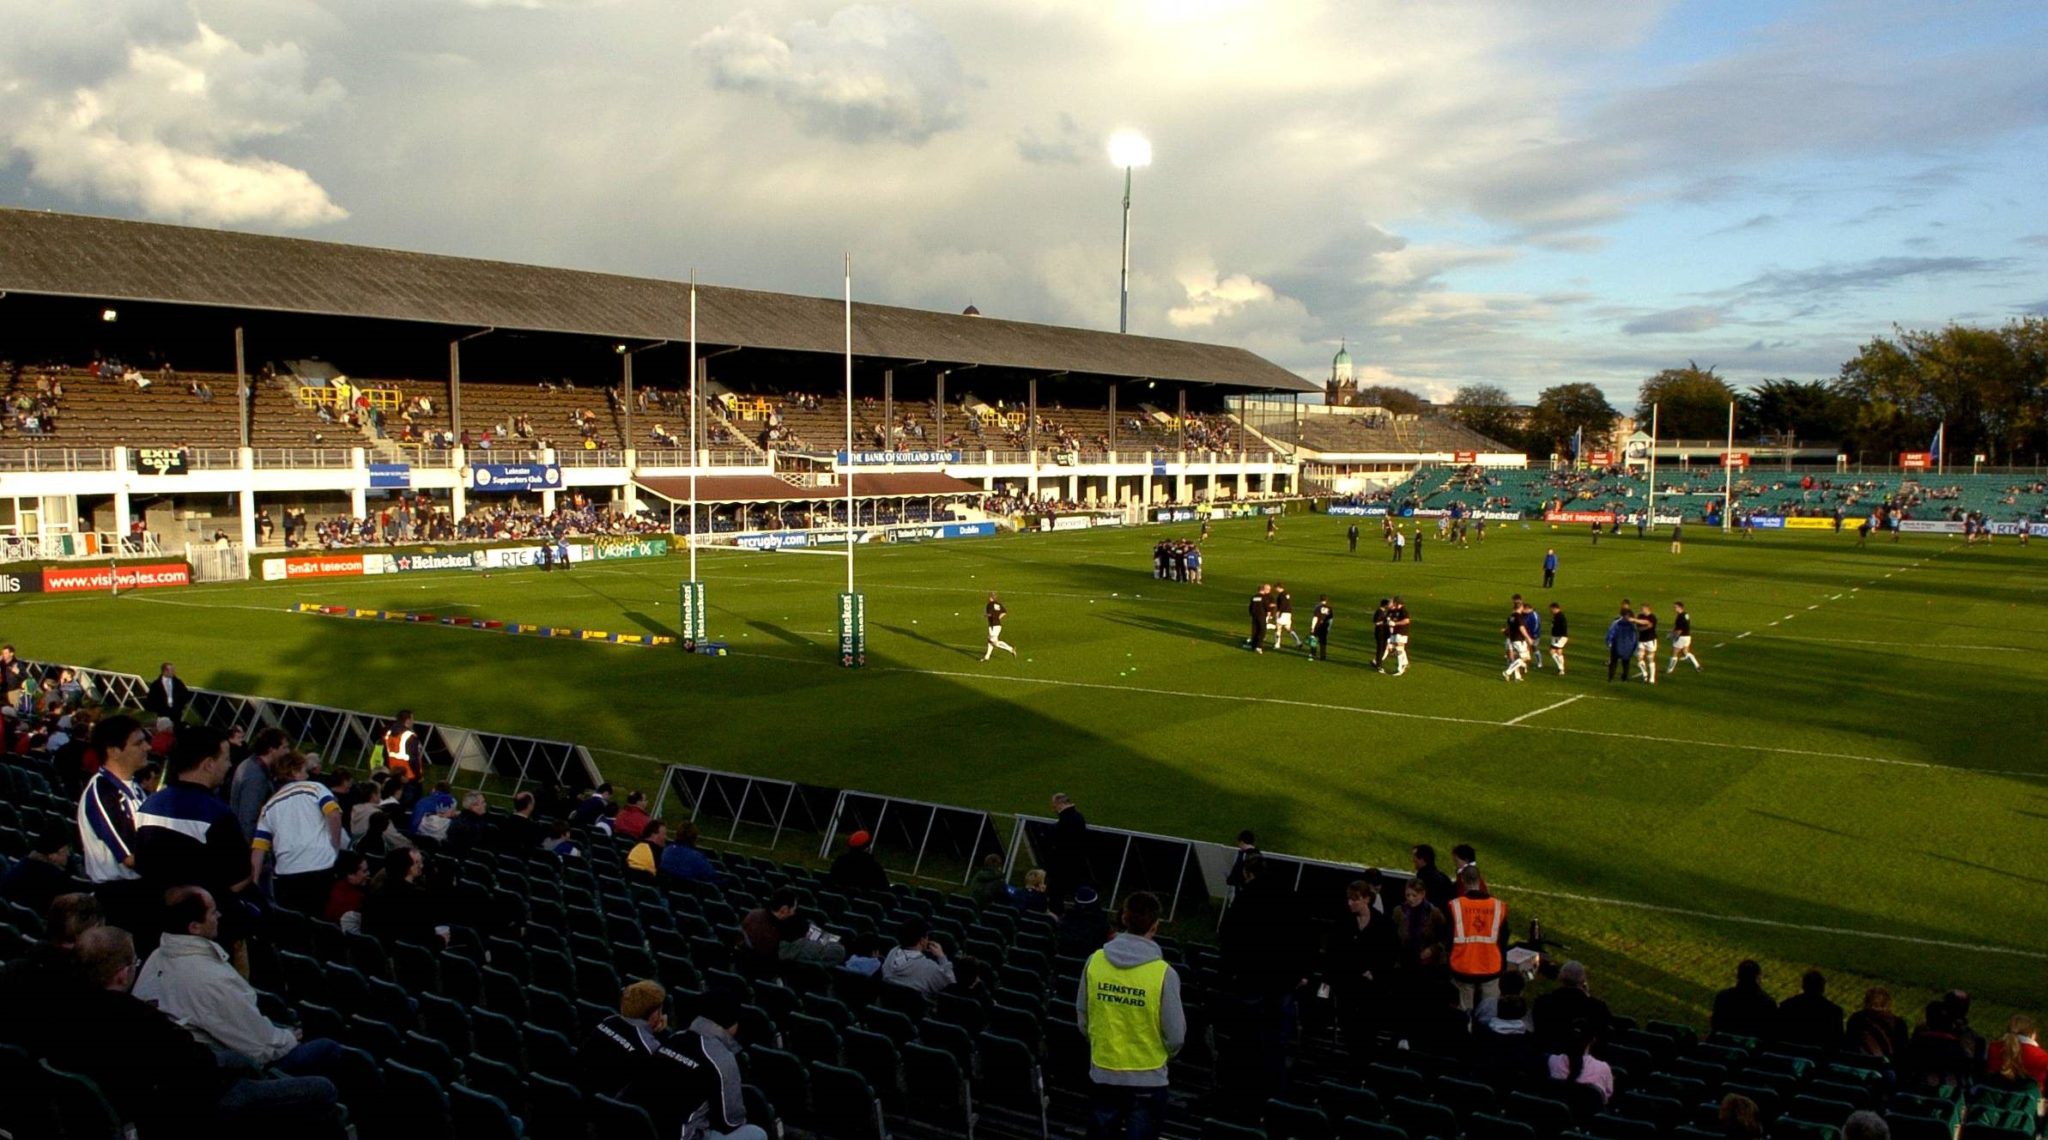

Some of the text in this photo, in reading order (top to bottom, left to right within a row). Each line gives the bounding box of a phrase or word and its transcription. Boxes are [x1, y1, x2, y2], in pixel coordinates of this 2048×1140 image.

[140, 449, 181, 458] EXIT
[865, 453, 885, 462] BANK
[896, 452, 929, 462] SCOTLAND
[930, 452, 953, 462] STAND
[142, 458, 181, 466] GATE
[493, 475, 542, 485] Supporters Club
[1471, 510, 1520, 520] Heineken
[959, 525, 980, 534] Dublin
[321, 561, 362, 572] telecom
[411, 554, 473, 570] Heineken
[682, 584, 693, 639] Heineken
[697, 584, 705, 638] Heineken
[841, 594, 853, 653] Heineken
[1098, 981, 1146, 997] LEINSTER
[1096, 993, 1146, 1007] STEWARD
